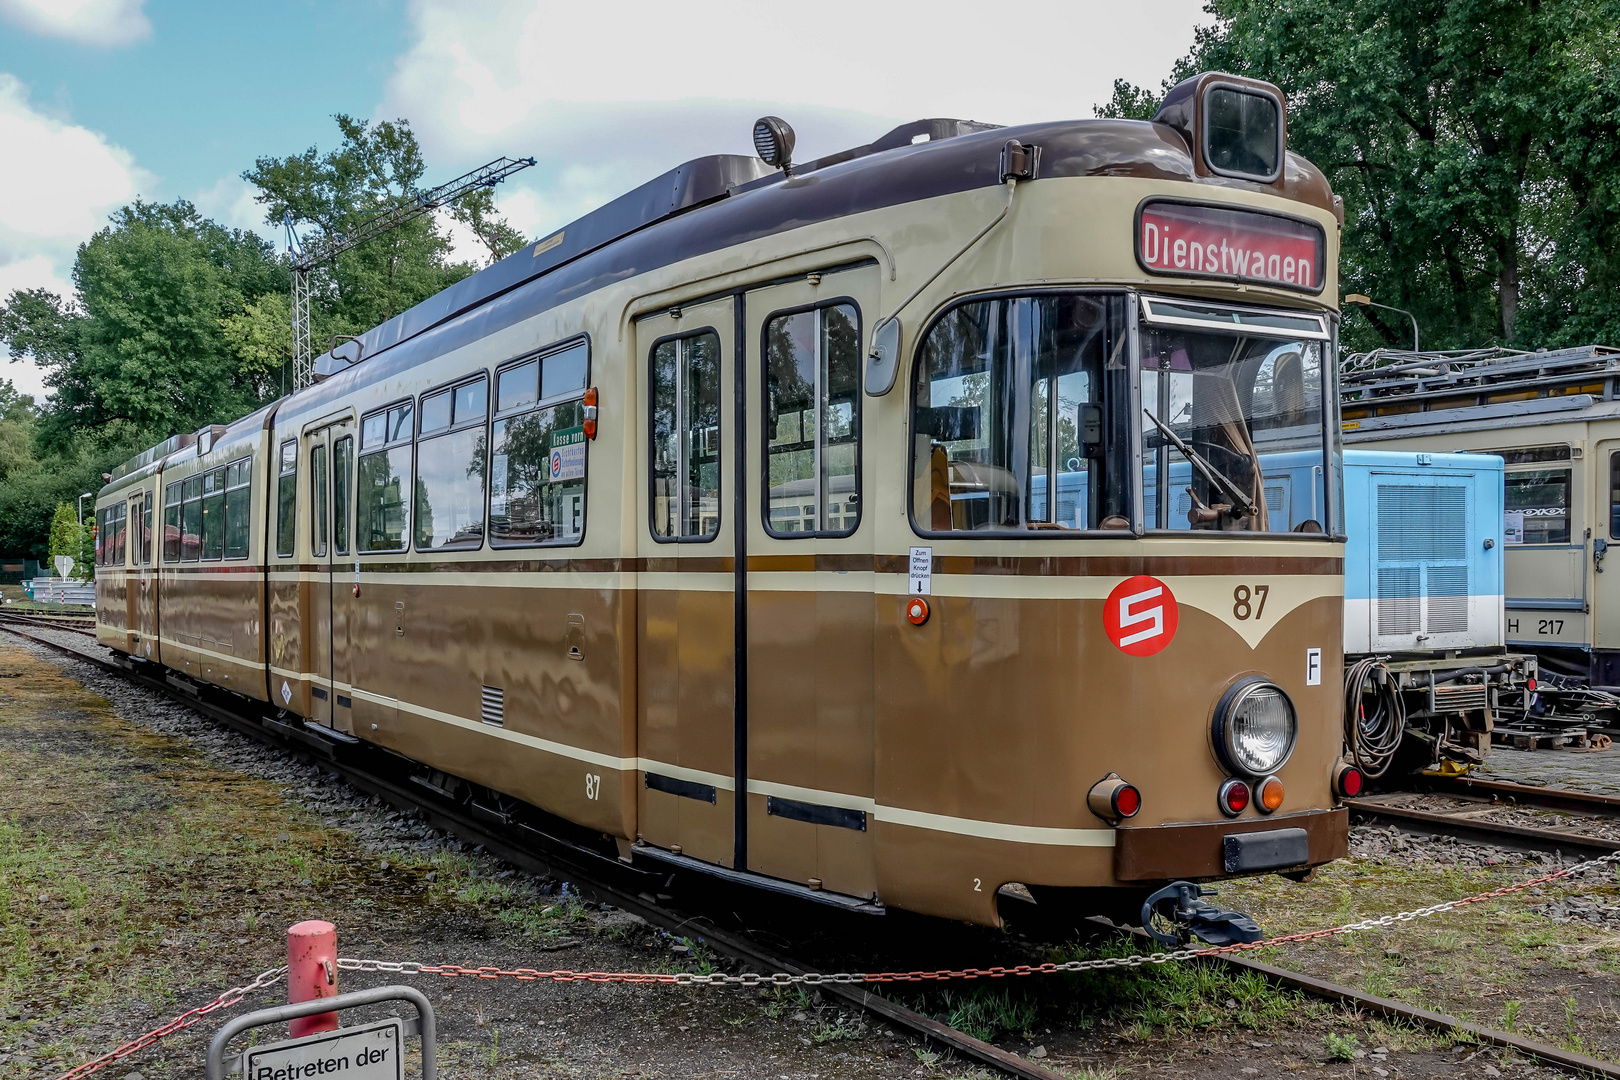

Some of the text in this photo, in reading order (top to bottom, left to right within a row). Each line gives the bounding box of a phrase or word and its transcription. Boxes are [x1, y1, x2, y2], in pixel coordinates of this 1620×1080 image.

[1144, 222, 1311, 286] Dienstwagen
[553, 431, 584, 446] Kasse vorn
[1232, 584, 1270, 621] 87
[1508, 619, 1564, 635] H 217
[1308, 652, 1320, 681] F
[585, 772, 601, 801] 87
[973, 877, 982, 892] 2
[258, 1046, 390, 1080] Betreten der
